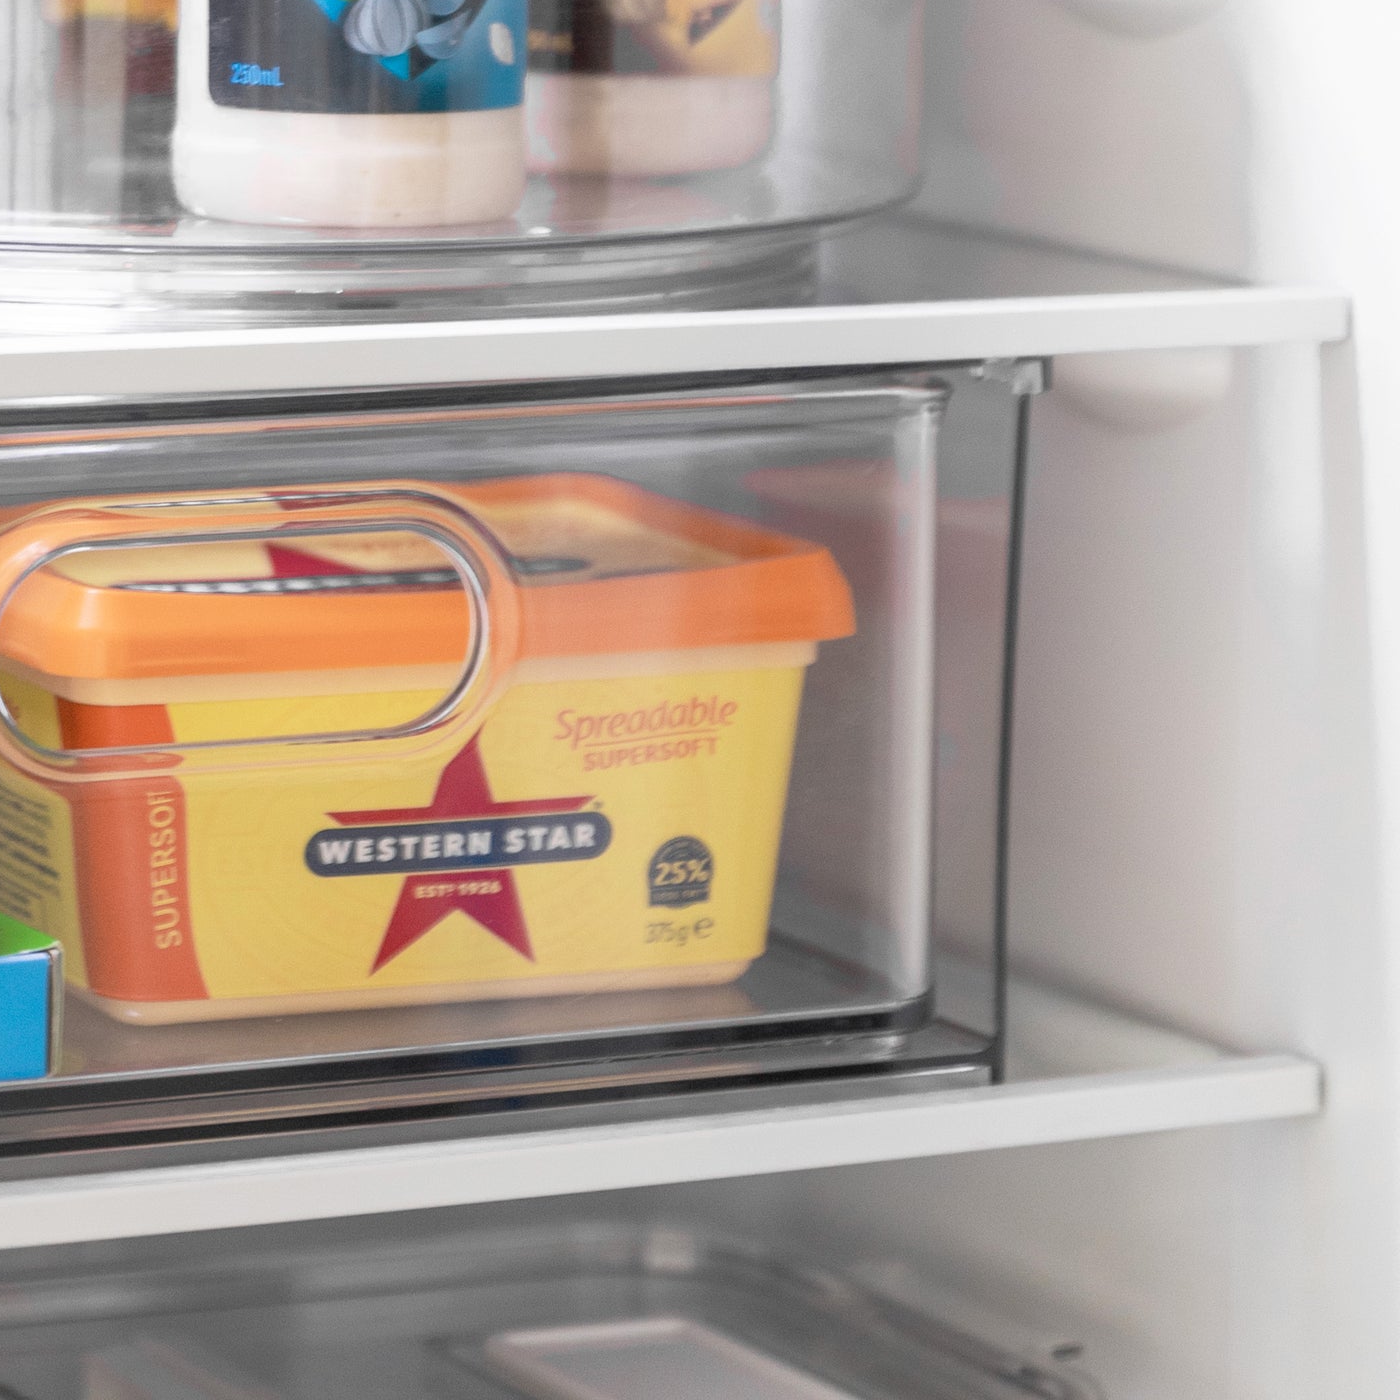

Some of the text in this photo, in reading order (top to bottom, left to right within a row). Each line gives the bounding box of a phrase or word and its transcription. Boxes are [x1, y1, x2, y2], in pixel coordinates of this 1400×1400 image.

[229, 61, 284, 87] 250mL
[553, 695, 739, 749] Spreadable
[582, 736, 720, 772] SUPERSOFT
[318, 823, 597, 865] WESTERN STAR
[654, 855, 711, 886] 25%
